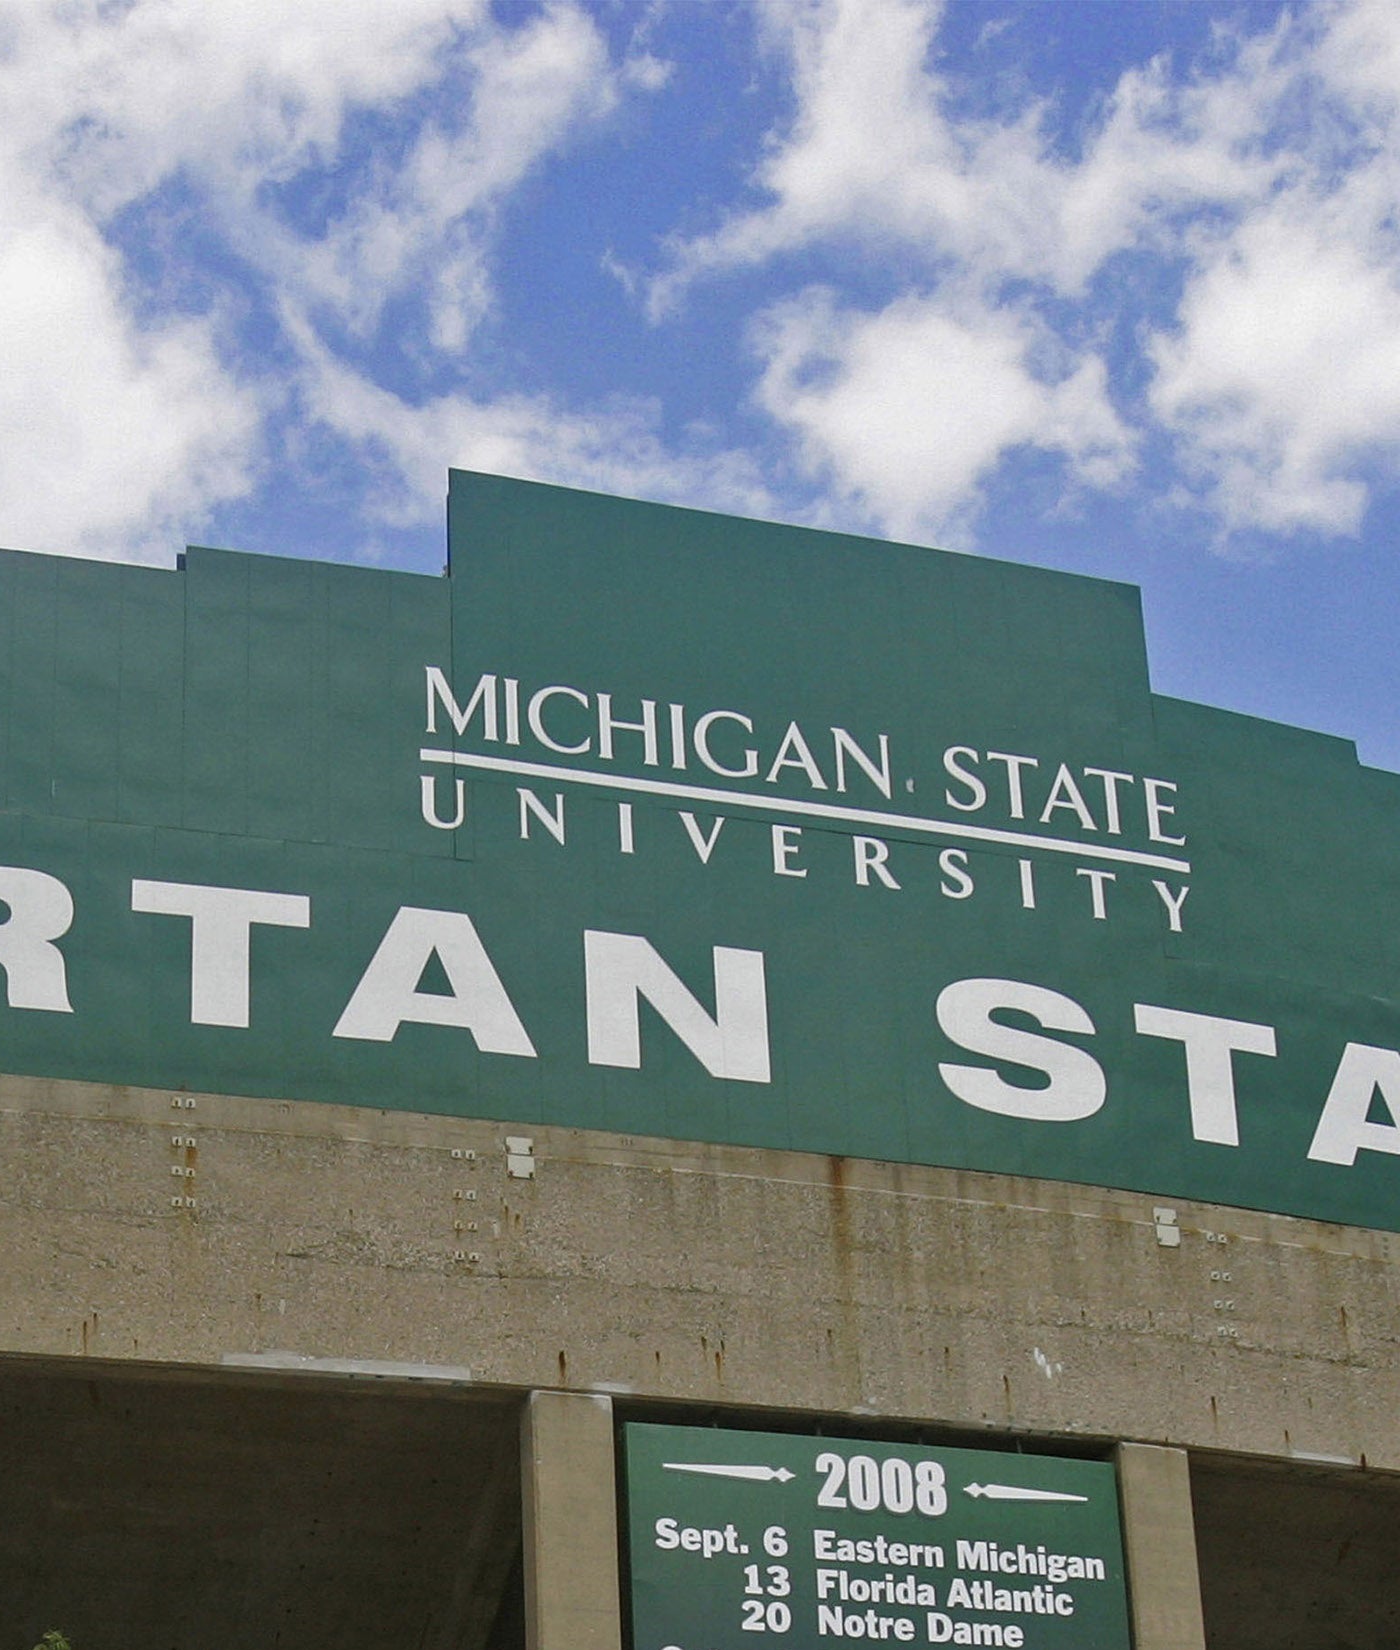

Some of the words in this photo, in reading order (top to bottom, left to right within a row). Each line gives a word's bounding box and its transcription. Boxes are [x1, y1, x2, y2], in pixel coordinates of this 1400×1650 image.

[425, 665, 893, 800] MICHIGAN
[943, 745, 1188, 847] STATE
[419, 775, 1192, 933] UNIVERSITY
[815, 1453, 948, 1516] 2008
[654, 1518, 750, 1558] Sept.
[763, 1526, 789, 1557] 6
[813, 1530, 944, 1569] Eastern
[956, 1540, 1106, 1583] Michigan
[743, 1564, 791, 1597] 13
[816, 1570, 936, 1607] Florida
[947, 1578, 1075, 1617] Atlantic
[741, 1601, 792, 1633] 20
[818, 1606, 915, 1642] Notre
[927, 1613, 1025, 1649] Dame
